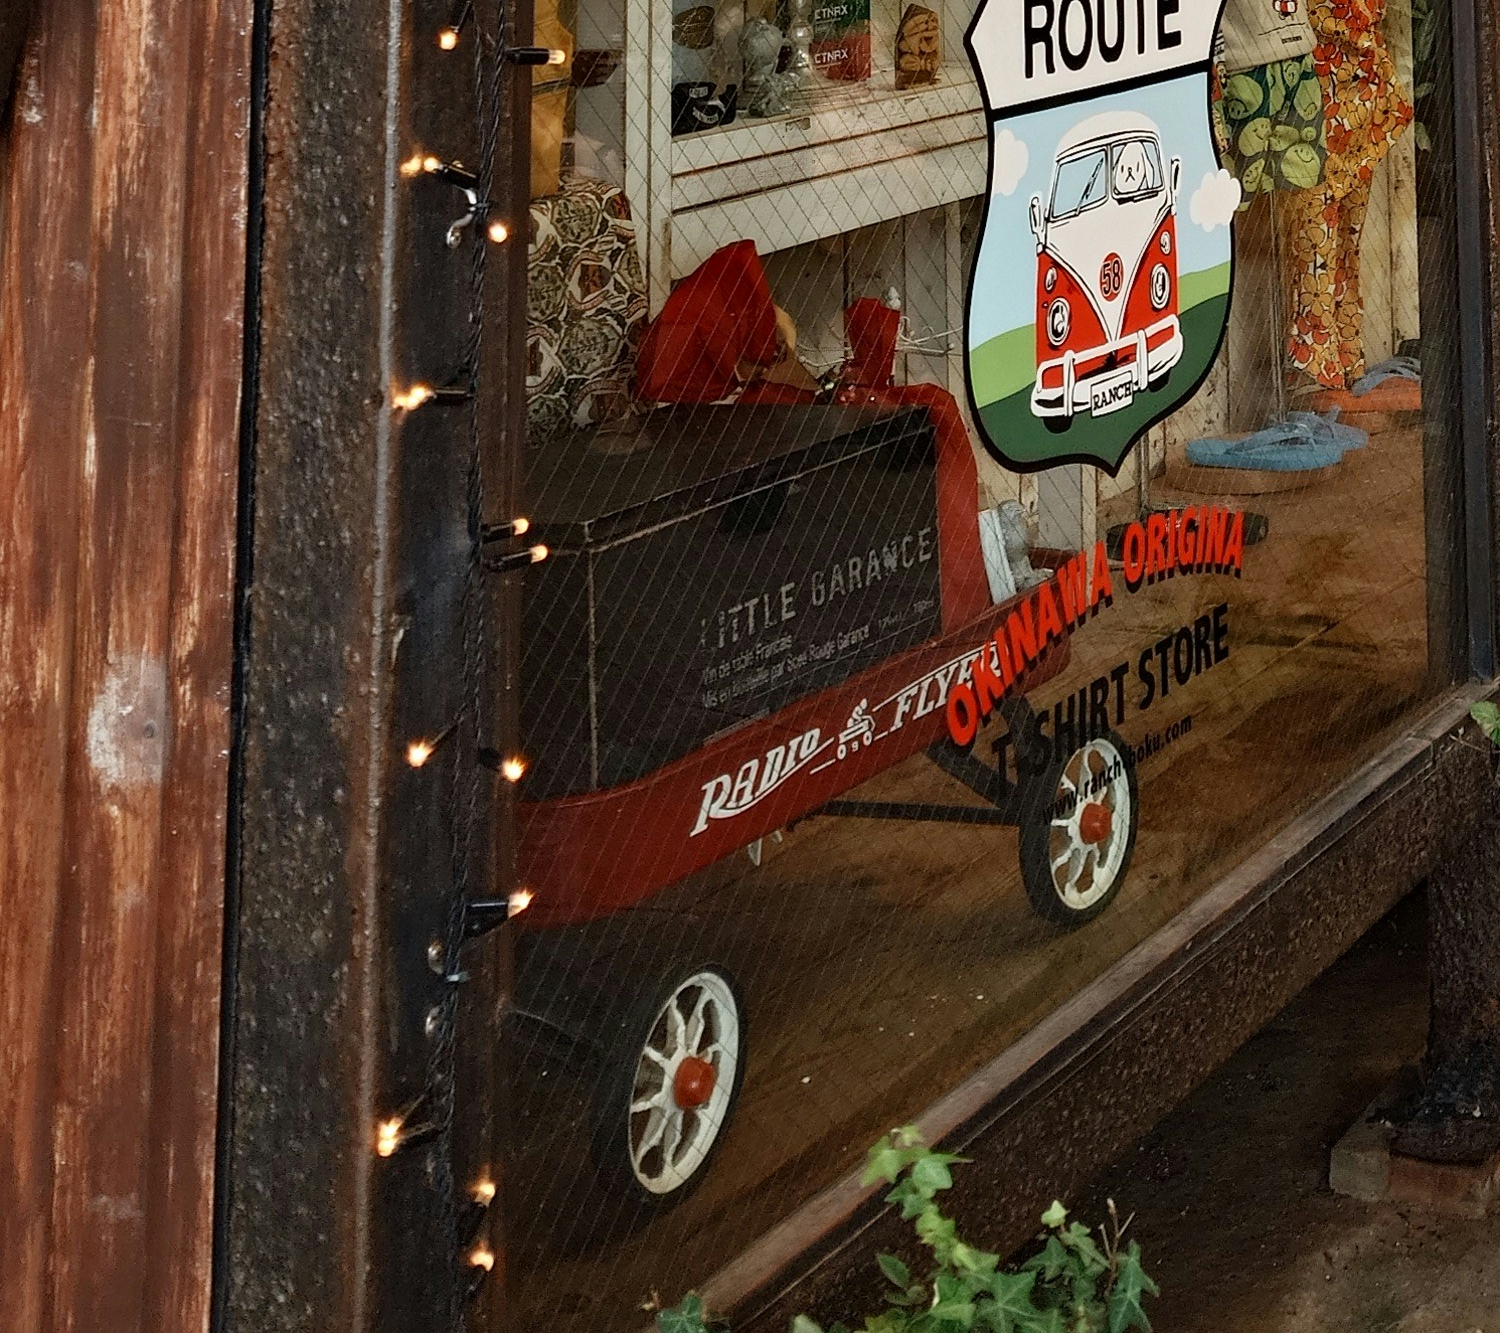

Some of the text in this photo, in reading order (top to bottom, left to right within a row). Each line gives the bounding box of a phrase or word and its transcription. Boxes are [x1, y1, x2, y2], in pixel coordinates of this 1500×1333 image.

[1102, 259, 1121, 296] 58
[1092, 382, 1132, 411] RANCH
[947, 540, 1113, 746] OKINAWA
[1138, 602, 1228, 710] STORE
[689, 728, 821, 838] RADIO
